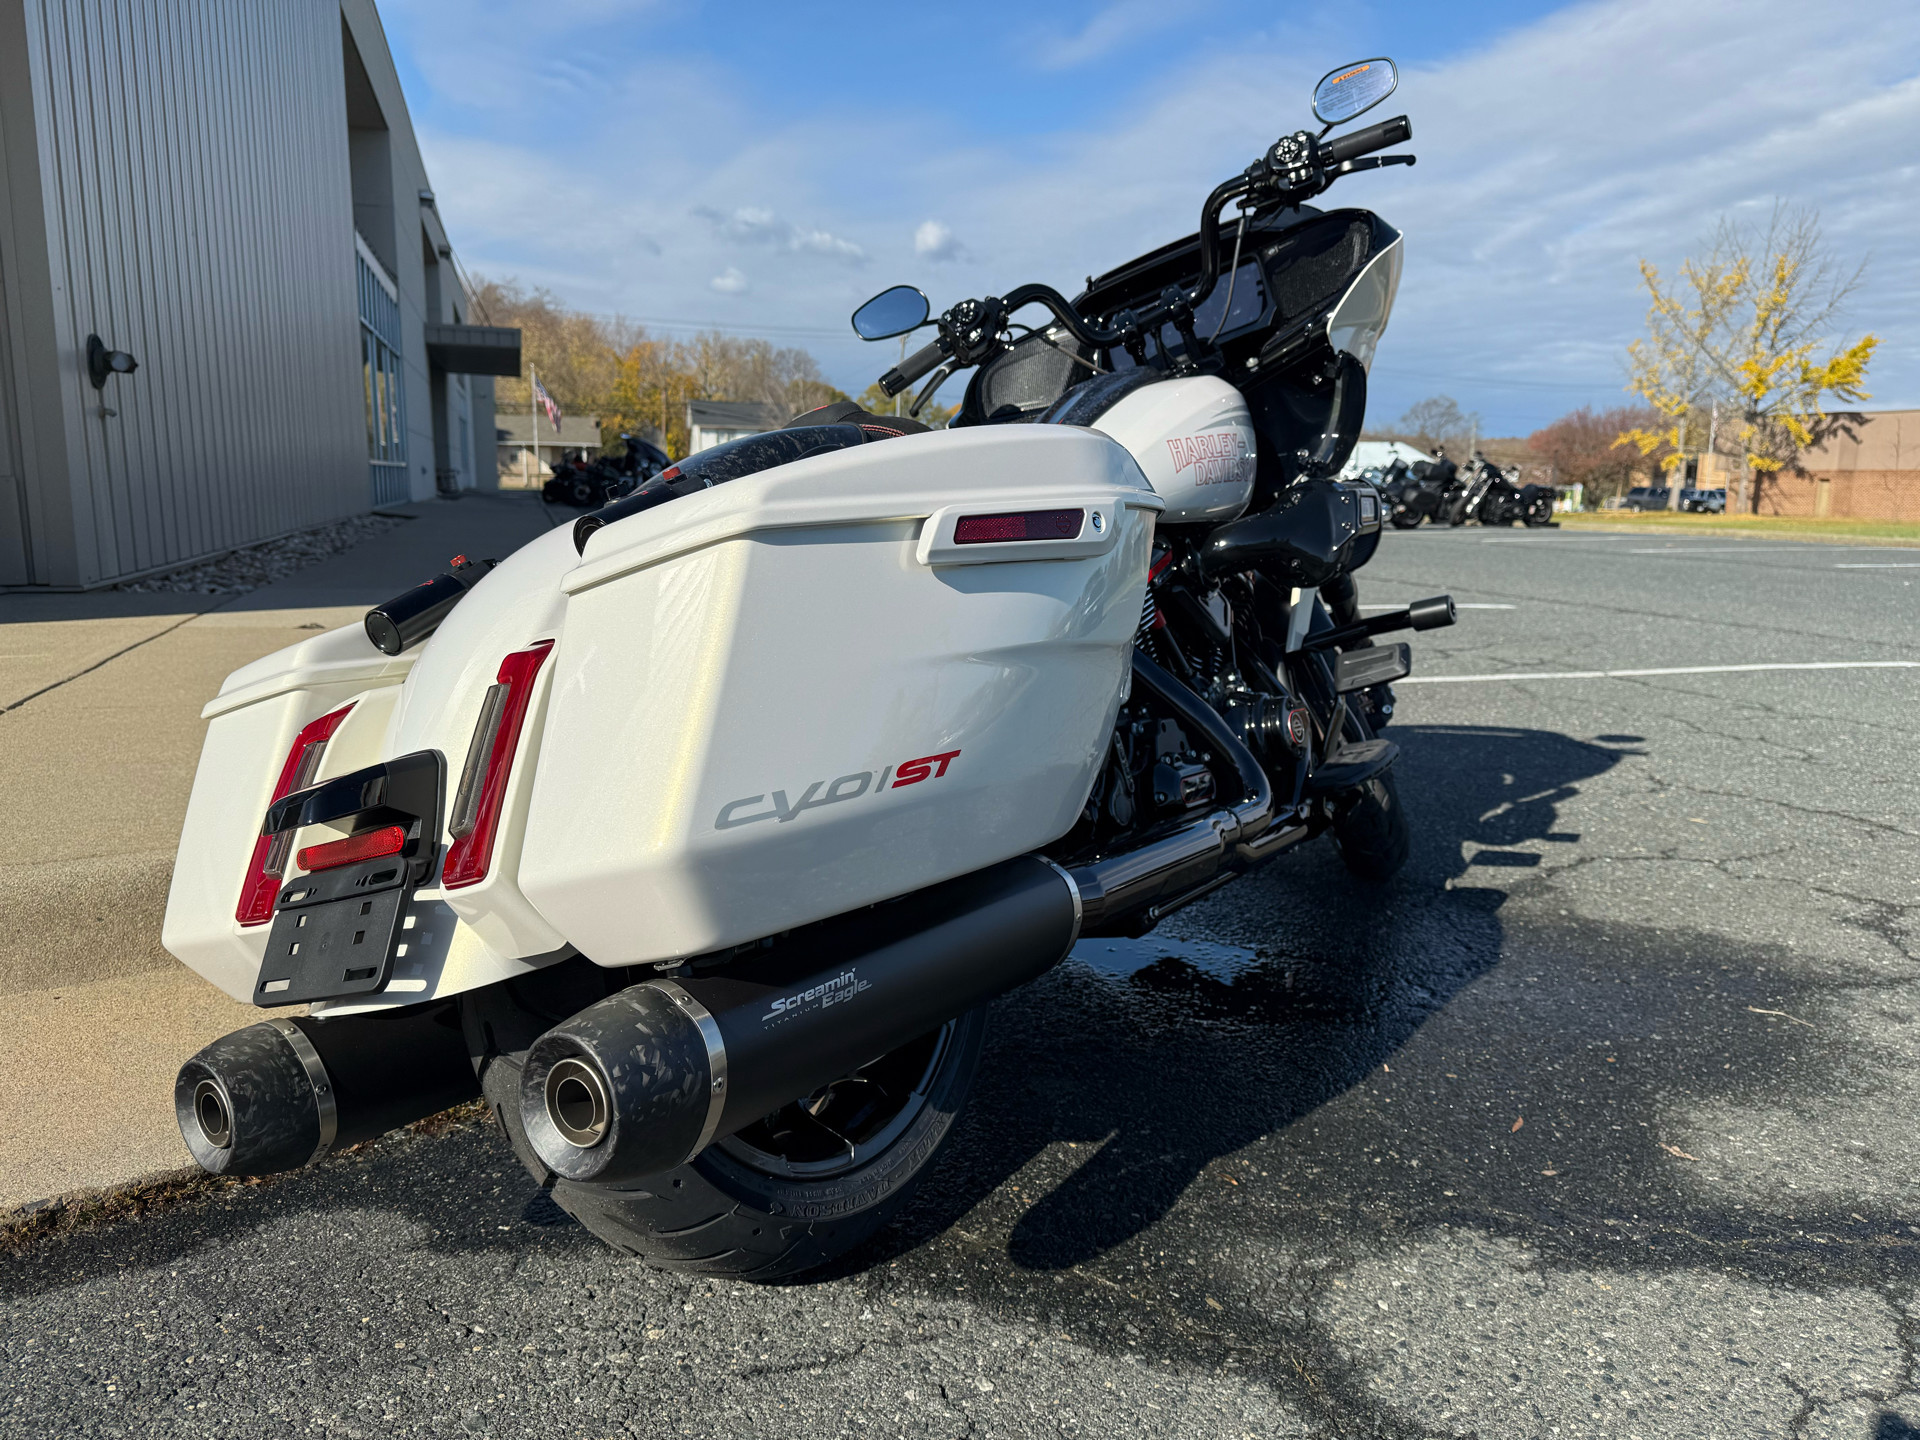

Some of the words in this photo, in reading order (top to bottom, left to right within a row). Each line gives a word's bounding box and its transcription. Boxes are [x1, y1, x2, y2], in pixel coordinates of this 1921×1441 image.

[1167, 433, 1246, 474] HARLEY-
[821, 979, 873, 1009] Eagle
[763, 1003, 819, 1031] TITANIUM
